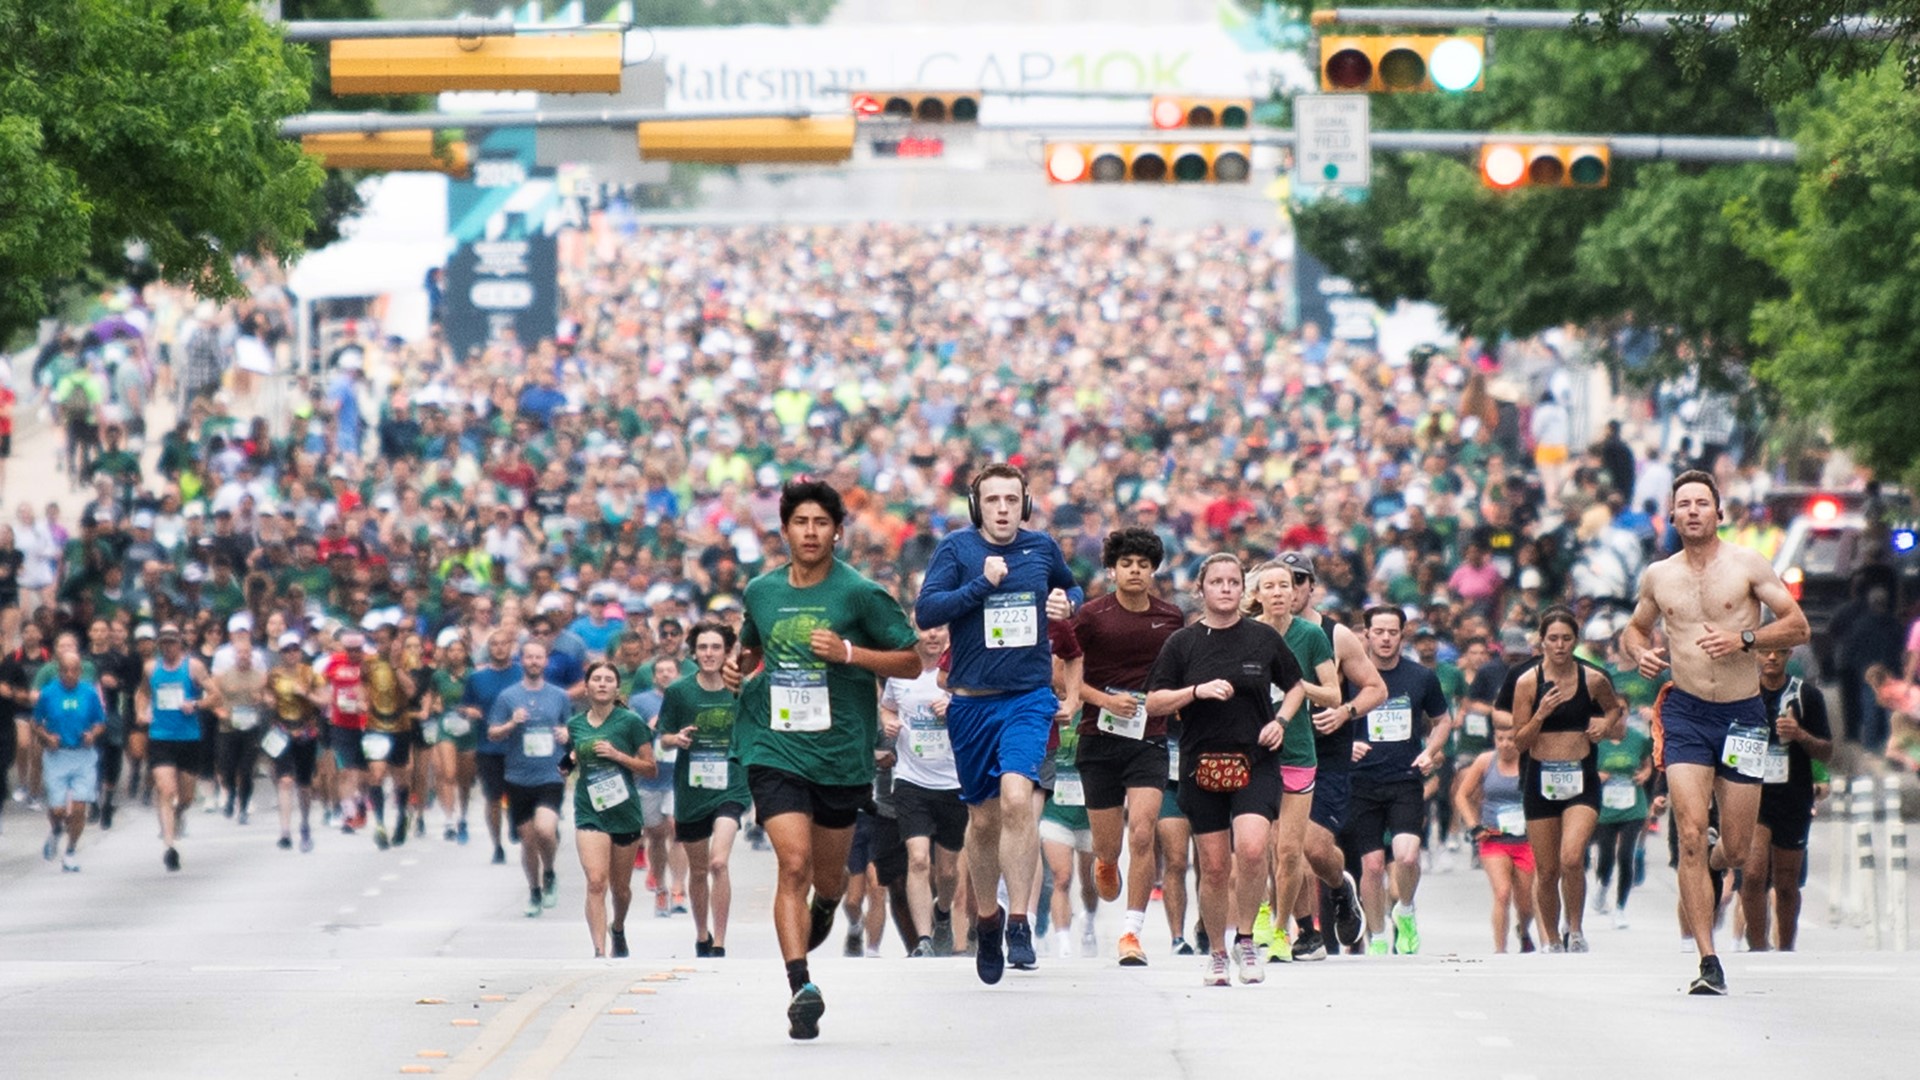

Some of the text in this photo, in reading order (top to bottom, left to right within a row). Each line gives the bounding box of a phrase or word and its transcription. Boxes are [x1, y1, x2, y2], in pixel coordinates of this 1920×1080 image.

[666, 61, 866, 101] tatesman
[1314, 116, 1348, 128] SIGNAL
[1313, 133, 1351, 149] YIELD
[1326, 151, 1358, 162] GREEN
[993, 609, 1029, 624] 2223
[786, 689, 811, 704] 176
[1375, 711, 1403, 723] 2314
[701, 763, 715, 774] 52
[1550, 773, 1573, 784] 1510
